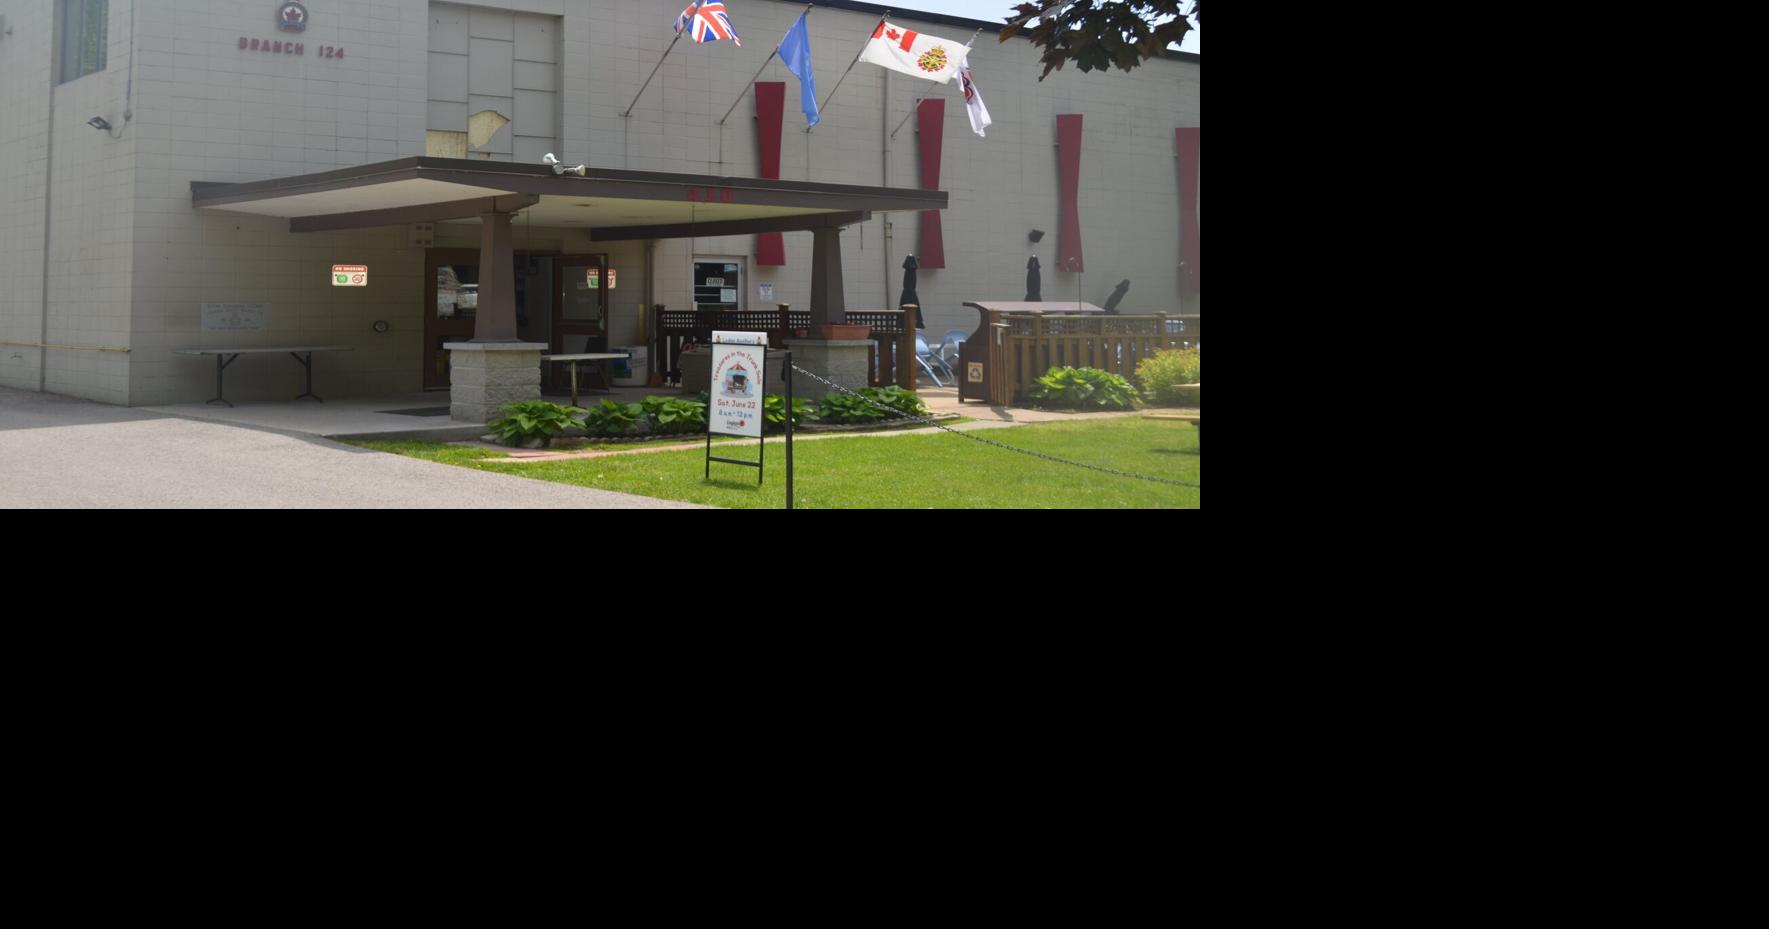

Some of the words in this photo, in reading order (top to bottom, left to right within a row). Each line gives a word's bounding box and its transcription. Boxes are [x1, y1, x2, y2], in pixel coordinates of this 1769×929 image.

[239, 37, 305, 55] BRANCH
[318, 45, 344, 59] 124
[732, 400, 746, 408] June
